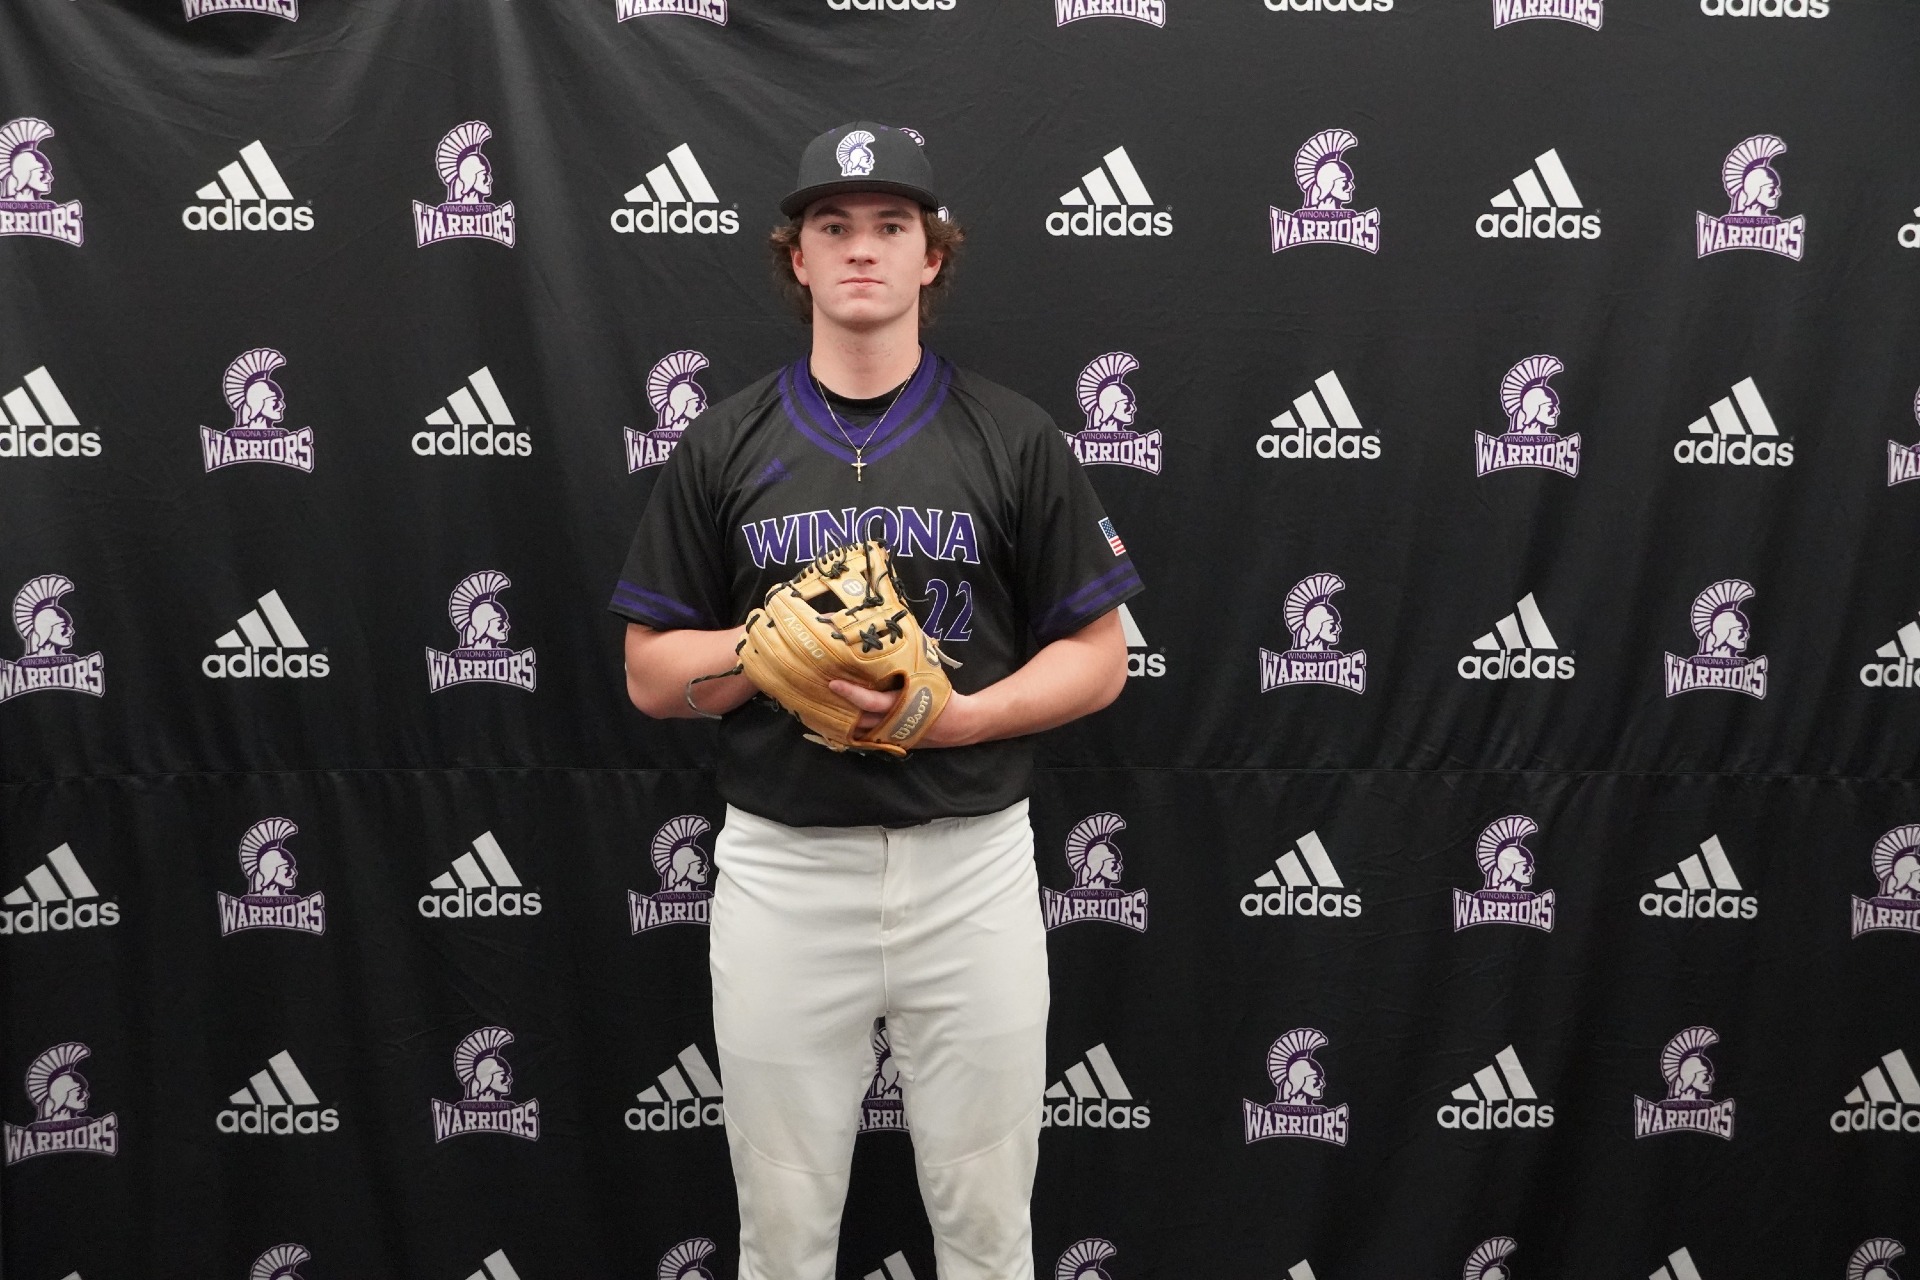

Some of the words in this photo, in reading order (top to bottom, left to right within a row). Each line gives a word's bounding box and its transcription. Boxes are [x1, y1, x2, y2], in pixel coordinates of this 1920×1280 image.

[1494, 0, 1602, 29] WARRIORS
[0, 202, 81, 244] RRIORS
[182, 199, 314, 231] adidas
[413, 202, 514, 247] WARRIORS
[610, 201, 739, 234] adidas
[1046, 204, 1173, 236] adidas
[1270, 207, 1380, 253] WARRIORS
[1331, 211, 1351, 219] STATE
[1475, 207, 1601, 239] adidas
[1755, 217, 1776, 225] STATE
[1698, 212, 1804, 260] WARRIORS
[0, 425, 102, 457] didas
[201, 426, 313, 472] WARRIORS
[231, 430, 260, 438] WINONA
[263, 430, 283, 438] STATE
[411, 424, 532, 456] adidas
[1256, 427, 1381, 459] adidas
[1674, 433, 1794, 466] adidas
[1067, 432, 1159, 473] ARRIORS
[1475, 431, 1579, 477] WARRIORS
[742, 506, 980, 569] WINONA
[922, 578, 973, 642] 22
[455, 650, 485, 658] WINONA
[784, 616, 825, 660] A2000
[23, 658, 52, 667] WINONA
[54, 656, 73, 665] STATE
[202, 646, 330, 678] adidas
[427, 648, 536, 692] WARRIORS
[1260, 648, 1365, 694] WARRIORS
[1319, 653, 1338, 661] STATE
[1457, 648, 1575, 680] adidas
[1860, 657, 1920, 687] adi
[0, 652, 103, 699] WARRIORS
[1665, 653, 1767, 699] WARRIORS
[891, 690, 930, 740] Wilson
[418, 886, 542, 918] adidas
[1043, 888, 1147, 932] WARRIORS
[1070, 890, 1099, 898] WINONA
[1101, 890, 1119, 898] STATE
[1240, 885, 1362, 917] adidas
[1453, 888, 1554, 932] WARRIORS
[1511, 892, 1531, 900] STATE
[1639, 888, 1758, 919] adidas
[219, 891, 324, 936] WARRIORS
[629, 891, 710, 934] WARRIO
[1852, 898, 1920, 937] WARRIO
[216, 1104, 340, 1135] adidas
[433, 1099, 539, 1142] WARRIORS
[624, 1097, 724, 1131] adida
[1243, 1098, 1349, 1145] WARRIORS
[1436, 1099, 1554, 1130] adidas
[1634, 1098, 1734, 1140] WARRIORS
[1830, 1101, 1920, 1132] adida
[4, 1114, 116, 1162] WARRIORS
